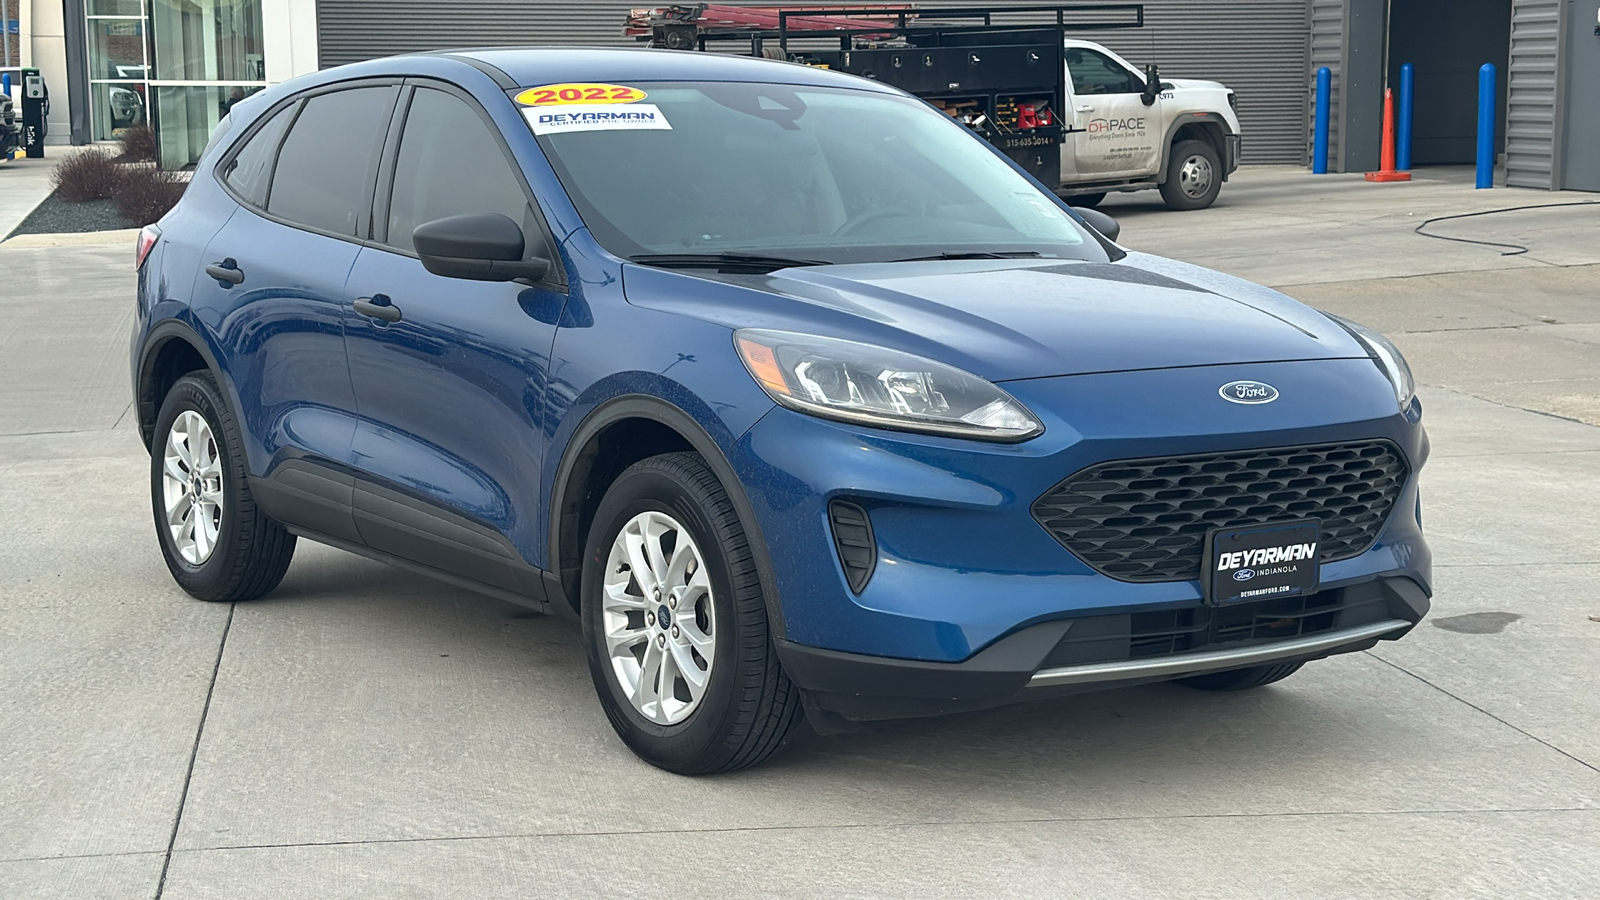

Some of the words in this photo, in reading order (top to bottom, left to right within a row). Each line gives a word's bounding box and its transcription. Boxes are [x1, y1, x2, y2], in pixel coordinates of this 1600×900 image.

[533, 87, 635, 104] 2022
[539, 112, 655, 124] DEYARMAN
[549, 119, 599, 127] CERTIFIED
[1235, 383, 1268, 398] Ford
[1217, 542, 1317, 571] DEYARMAN
[1256, 565, 1298, 577] INDIANOLA
[1240, 585, 1290, 598] DEYARMANFORD.COM
